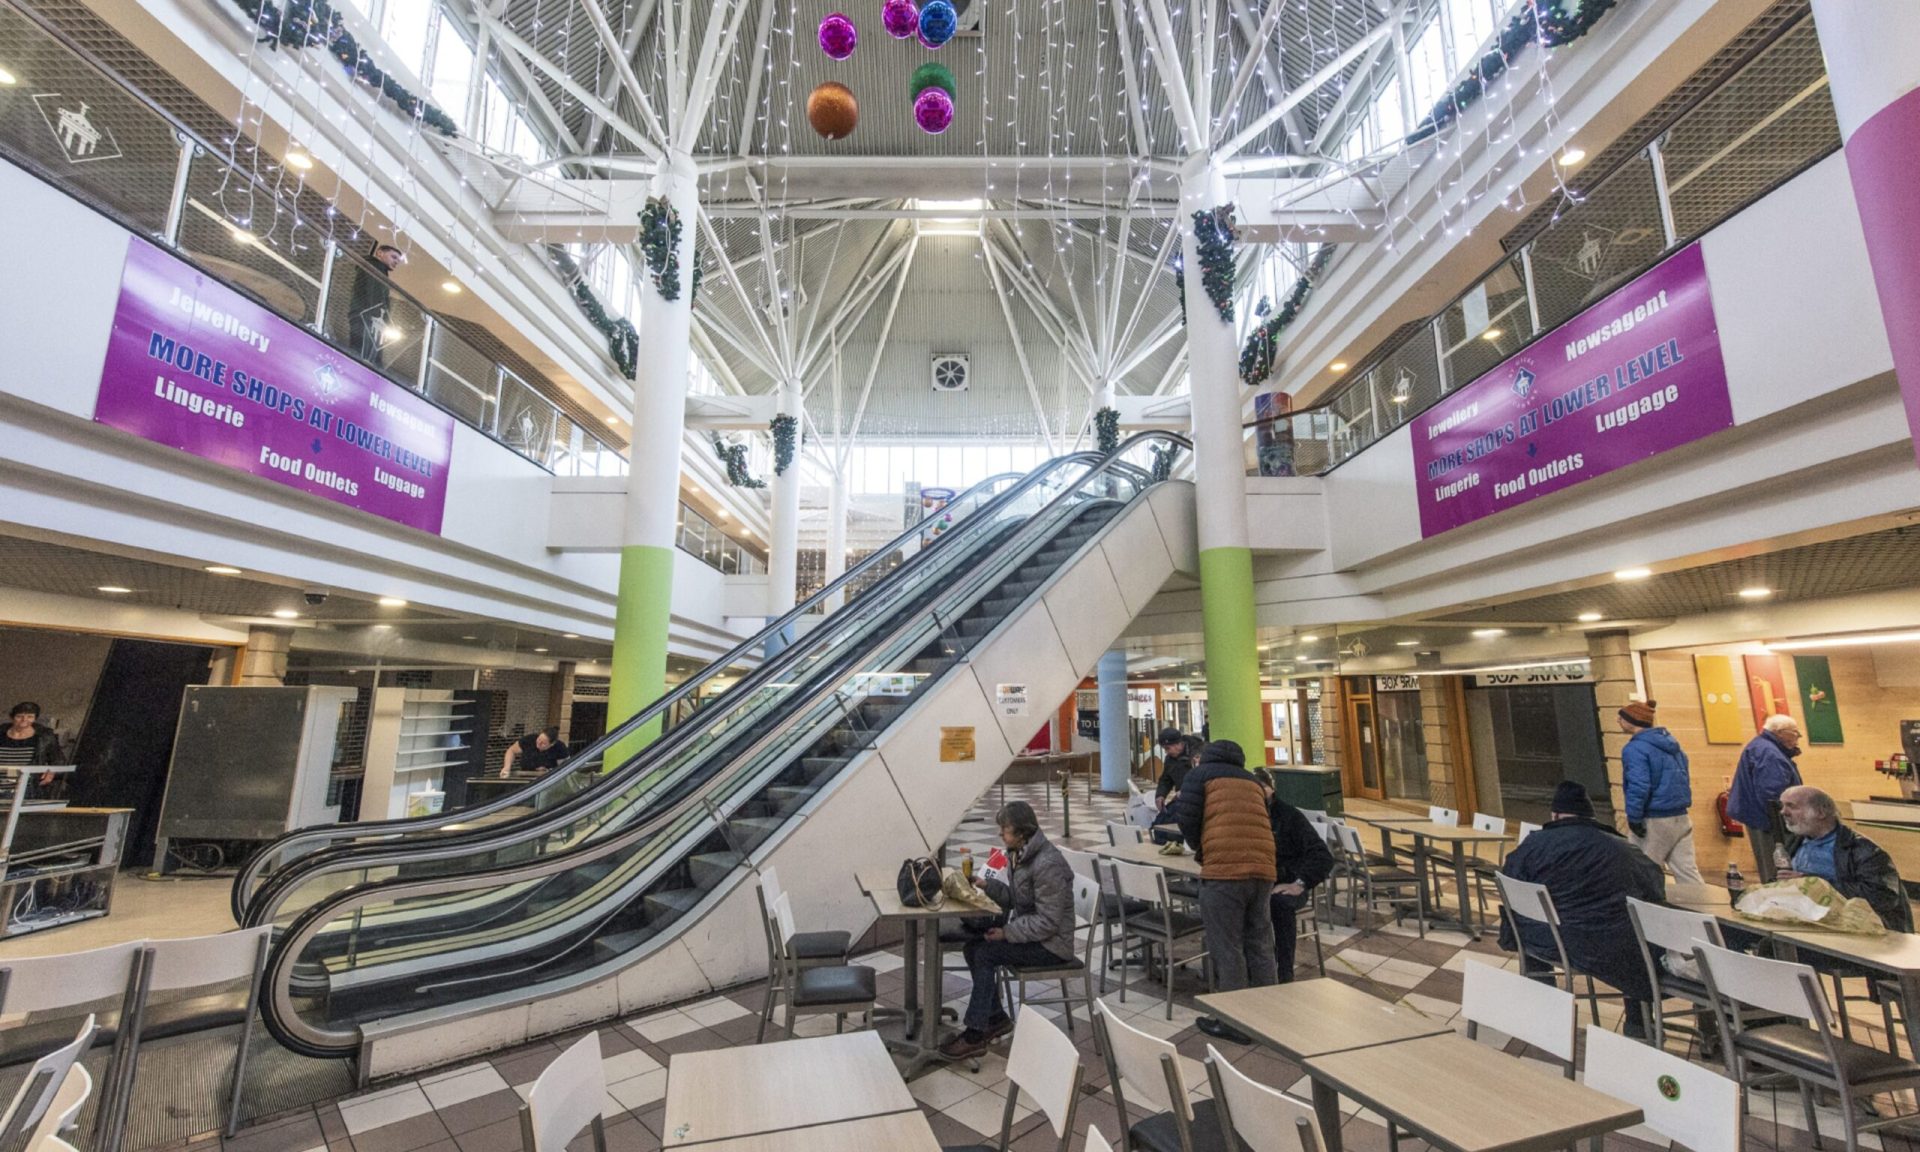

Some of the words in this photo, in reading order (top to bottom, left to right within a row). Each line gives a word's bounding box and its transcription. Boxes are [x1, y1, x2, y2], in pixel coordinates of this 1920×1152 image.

[169, 287, 270, 353] Jewellery
[1565, 289, 1669, 362] Newsagent
[148, 331, 226, 388] MORE
[232, 369, 306, 421] SHOPS
[309, 405, 333, 432] AT
[336, 418, 392, 459] LOWER
[394, 447, 433, 478] LEVEL
[154, 376, 245, 428] Lingerie
[369, 391, 437, 440] Newsagent
[1428, 448, 1464, 481] MORE
[1466, 423, 1515, 463] SHOPS
[1518, 410, 1539, 438] AT
[1543, 375, 1610, 427] LOWER
[1615, 337, 1684, 392] LEVEL
[1428, 401, 1479, 440] Jewellery
[1595, 384, 1679, 433] Luggage
[259, 445, 302, 476] Food
[304, 462, 359, 496] Outlets
[374, 466, 425, 499] Luggage
[1435, 472, 1480, 502] Lingerie
[1494, 474, 1526, 500] Food
[1528, 453, 1584, 486] Outlets
[1381, 675, 1398, 689] BOX
[1080, 719, 1092, 728] TO
